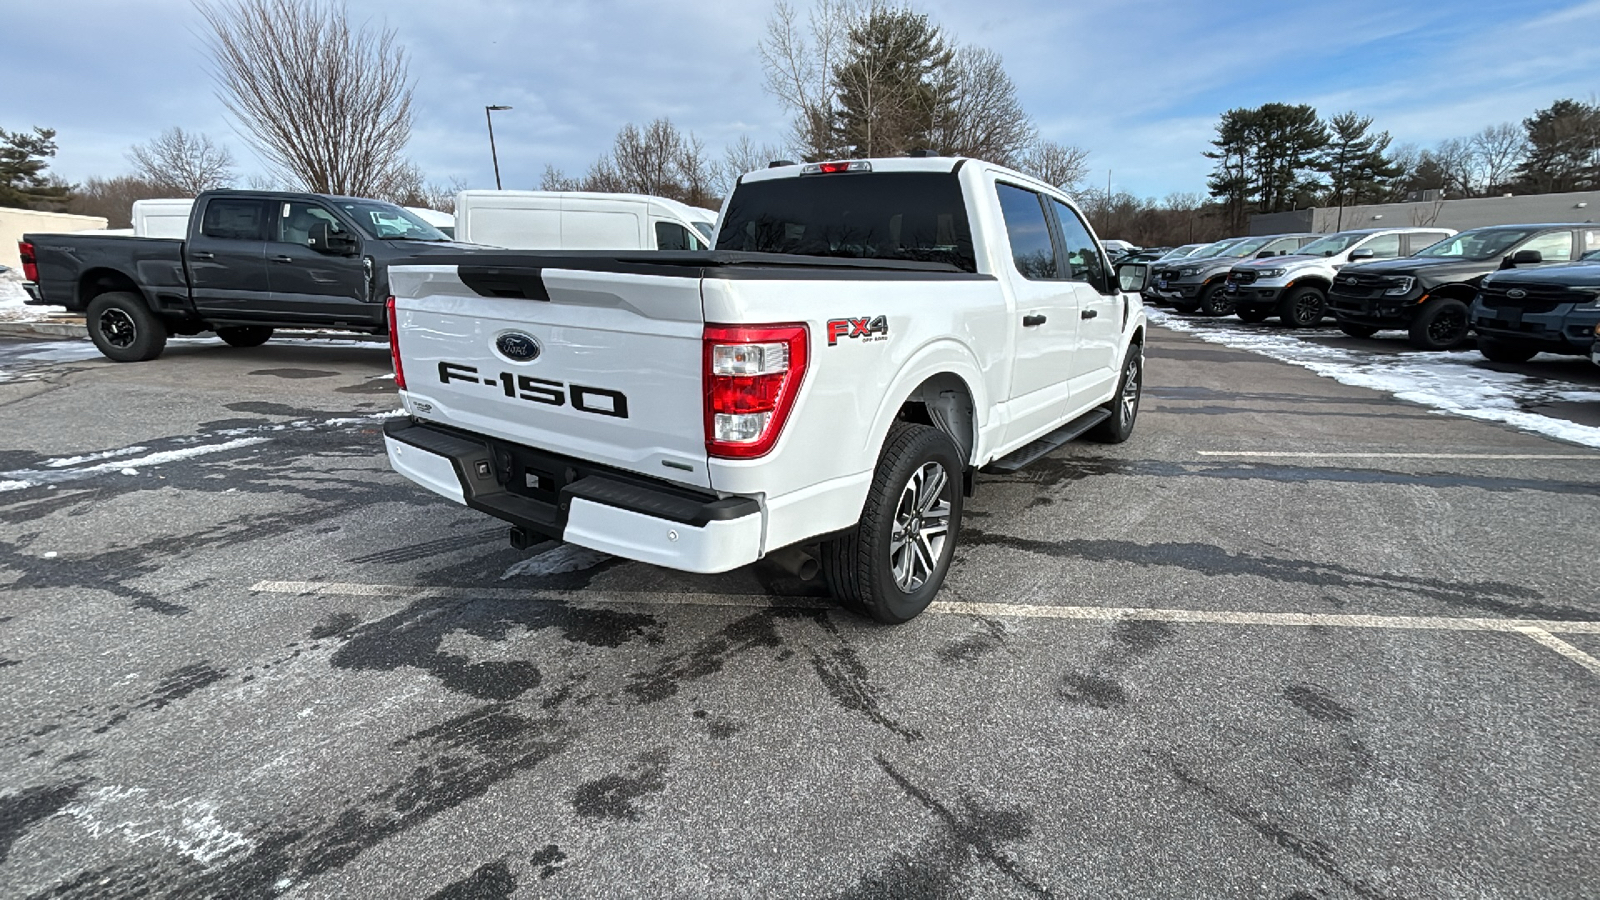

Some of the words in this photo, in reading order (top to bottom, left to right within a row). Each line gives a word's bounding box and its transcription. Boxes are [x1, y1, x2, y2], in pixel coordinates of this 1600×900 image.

[503, 337, 528, 356] Ford
[827, 315, 888, 347] FX4
[438, 361, 629, 419] F-150
